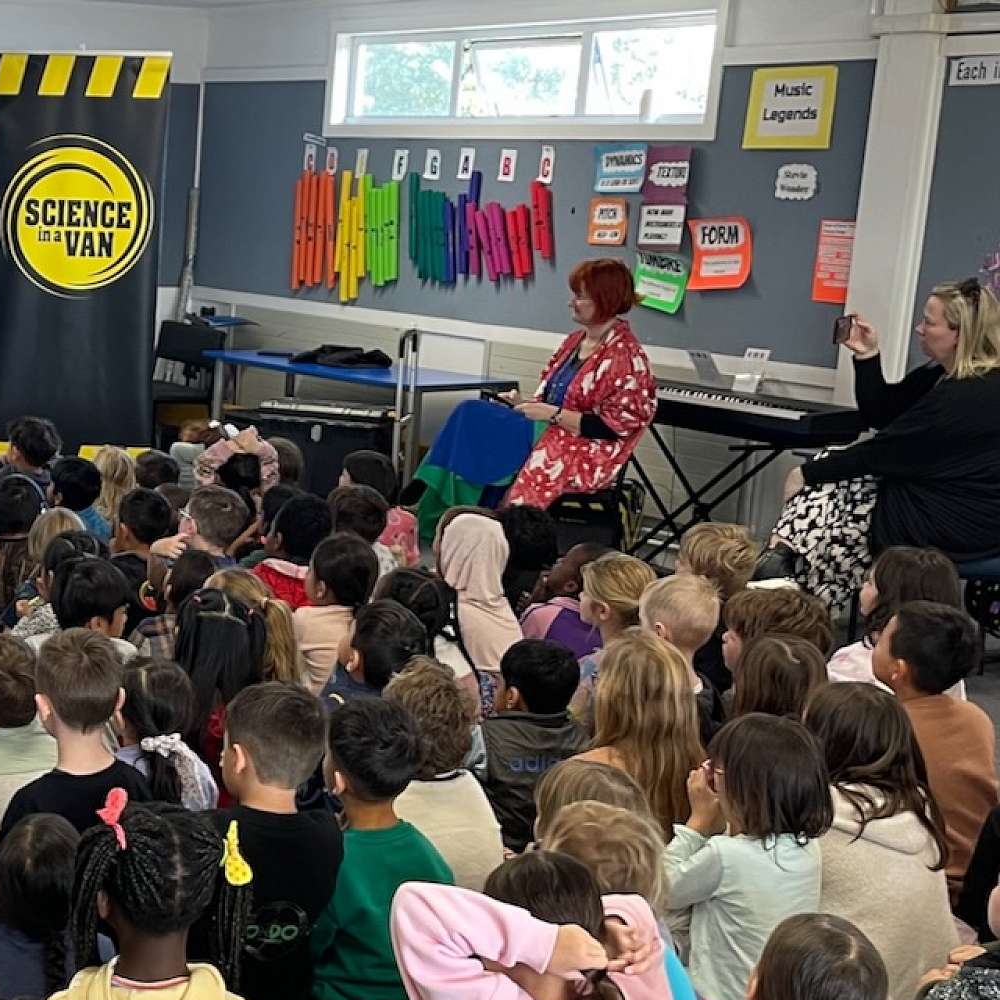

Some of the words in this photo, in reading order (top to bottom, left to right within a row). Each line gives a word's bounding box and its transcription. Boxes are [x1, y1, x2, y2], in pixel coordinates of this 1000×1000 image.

[956, 61, 987, 80] Each
[774, 82, 813, 97] Music
[763, 107, 817, 123] Legends
[397, 156, 404, 172] F
[430, 155, 439, 175] G
[461, 155, 470, 174] A
[502, 155, 512, 176] B
[541, 158, 550, 178] C
[25, 199, 132, 228] SCIENCE
[38, 227, 51, 242] in
[53, 230, 62, 242] a
[64, 230, 114, 258] VAN
[701, 225, 740, 245] FORM
